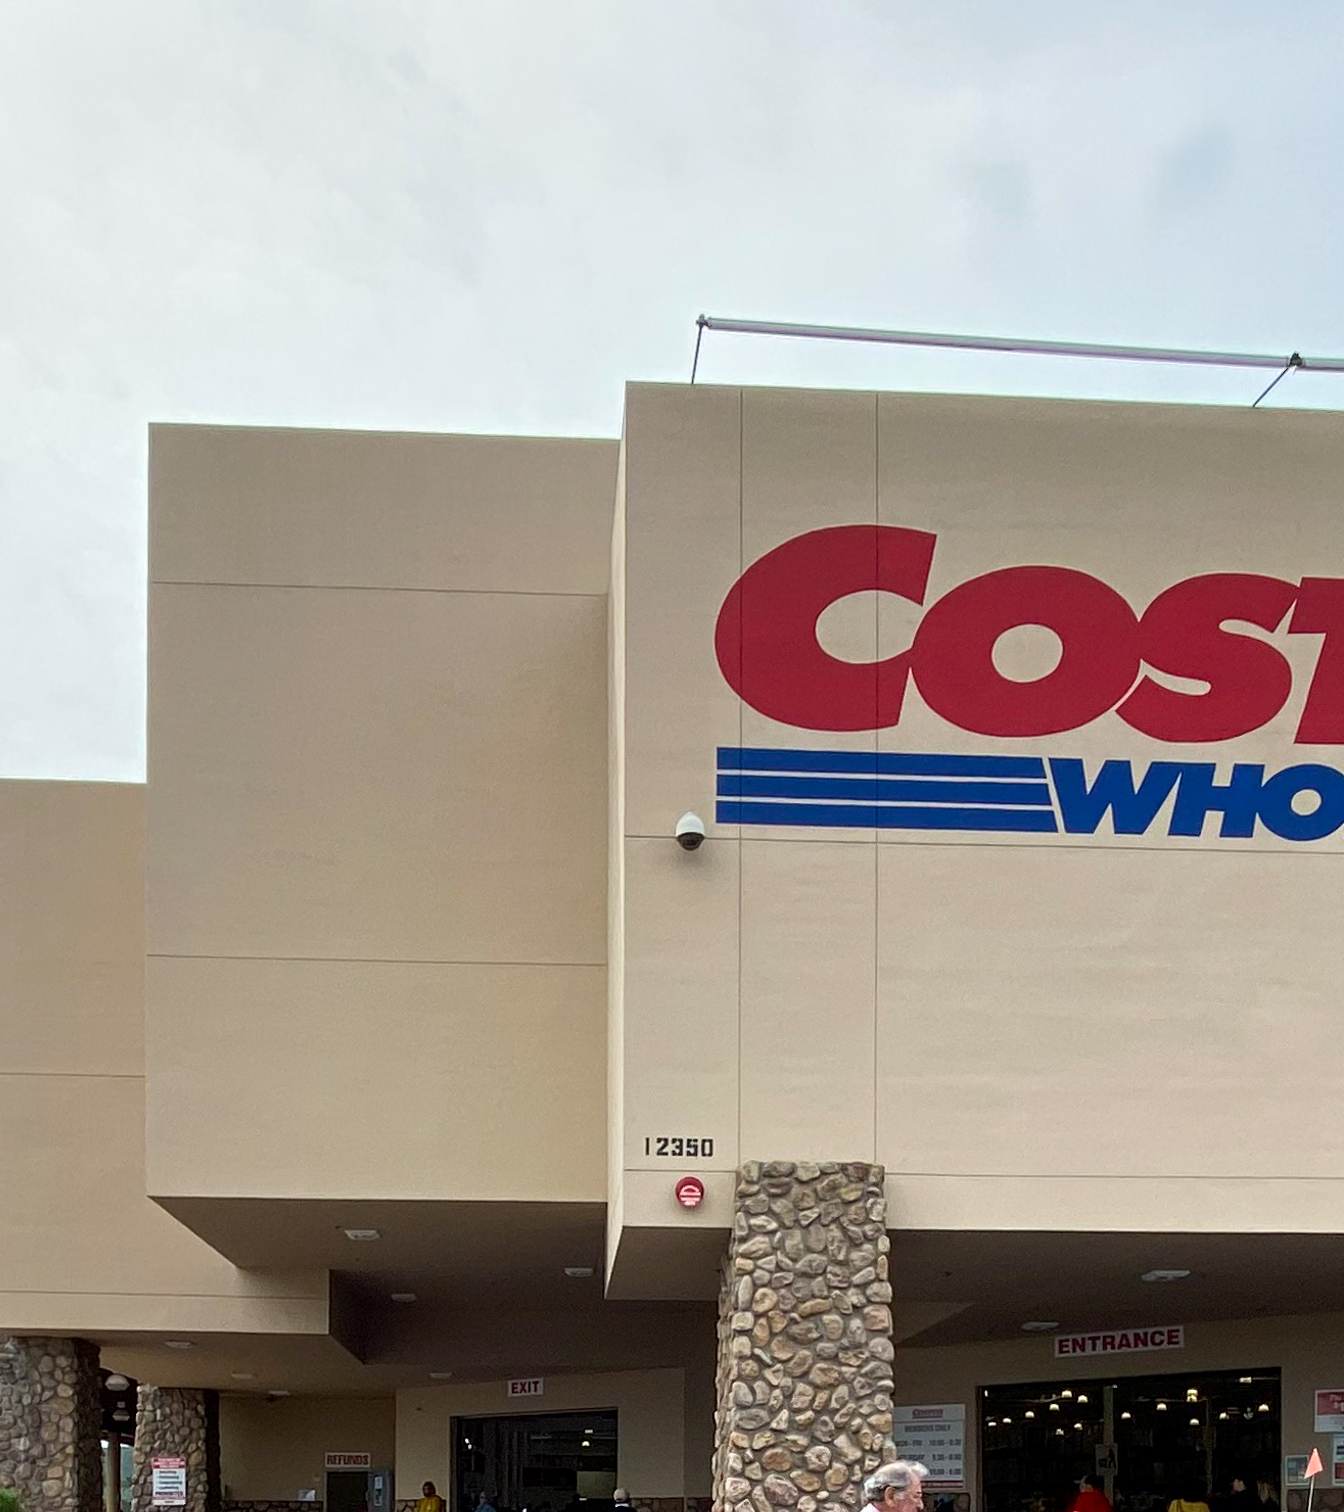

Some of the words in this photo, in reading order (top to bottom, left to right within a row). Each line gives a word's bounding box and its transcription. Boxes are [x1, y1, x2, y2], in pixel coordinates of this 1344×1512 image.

[645, 1137, 714, 1157] 12350
[1058, 1329, 1180, 1354] ENTRANCE
[511, 1381, 540, 1394] EXIT
[326, 1454, 370, 1465] REFUNDS
